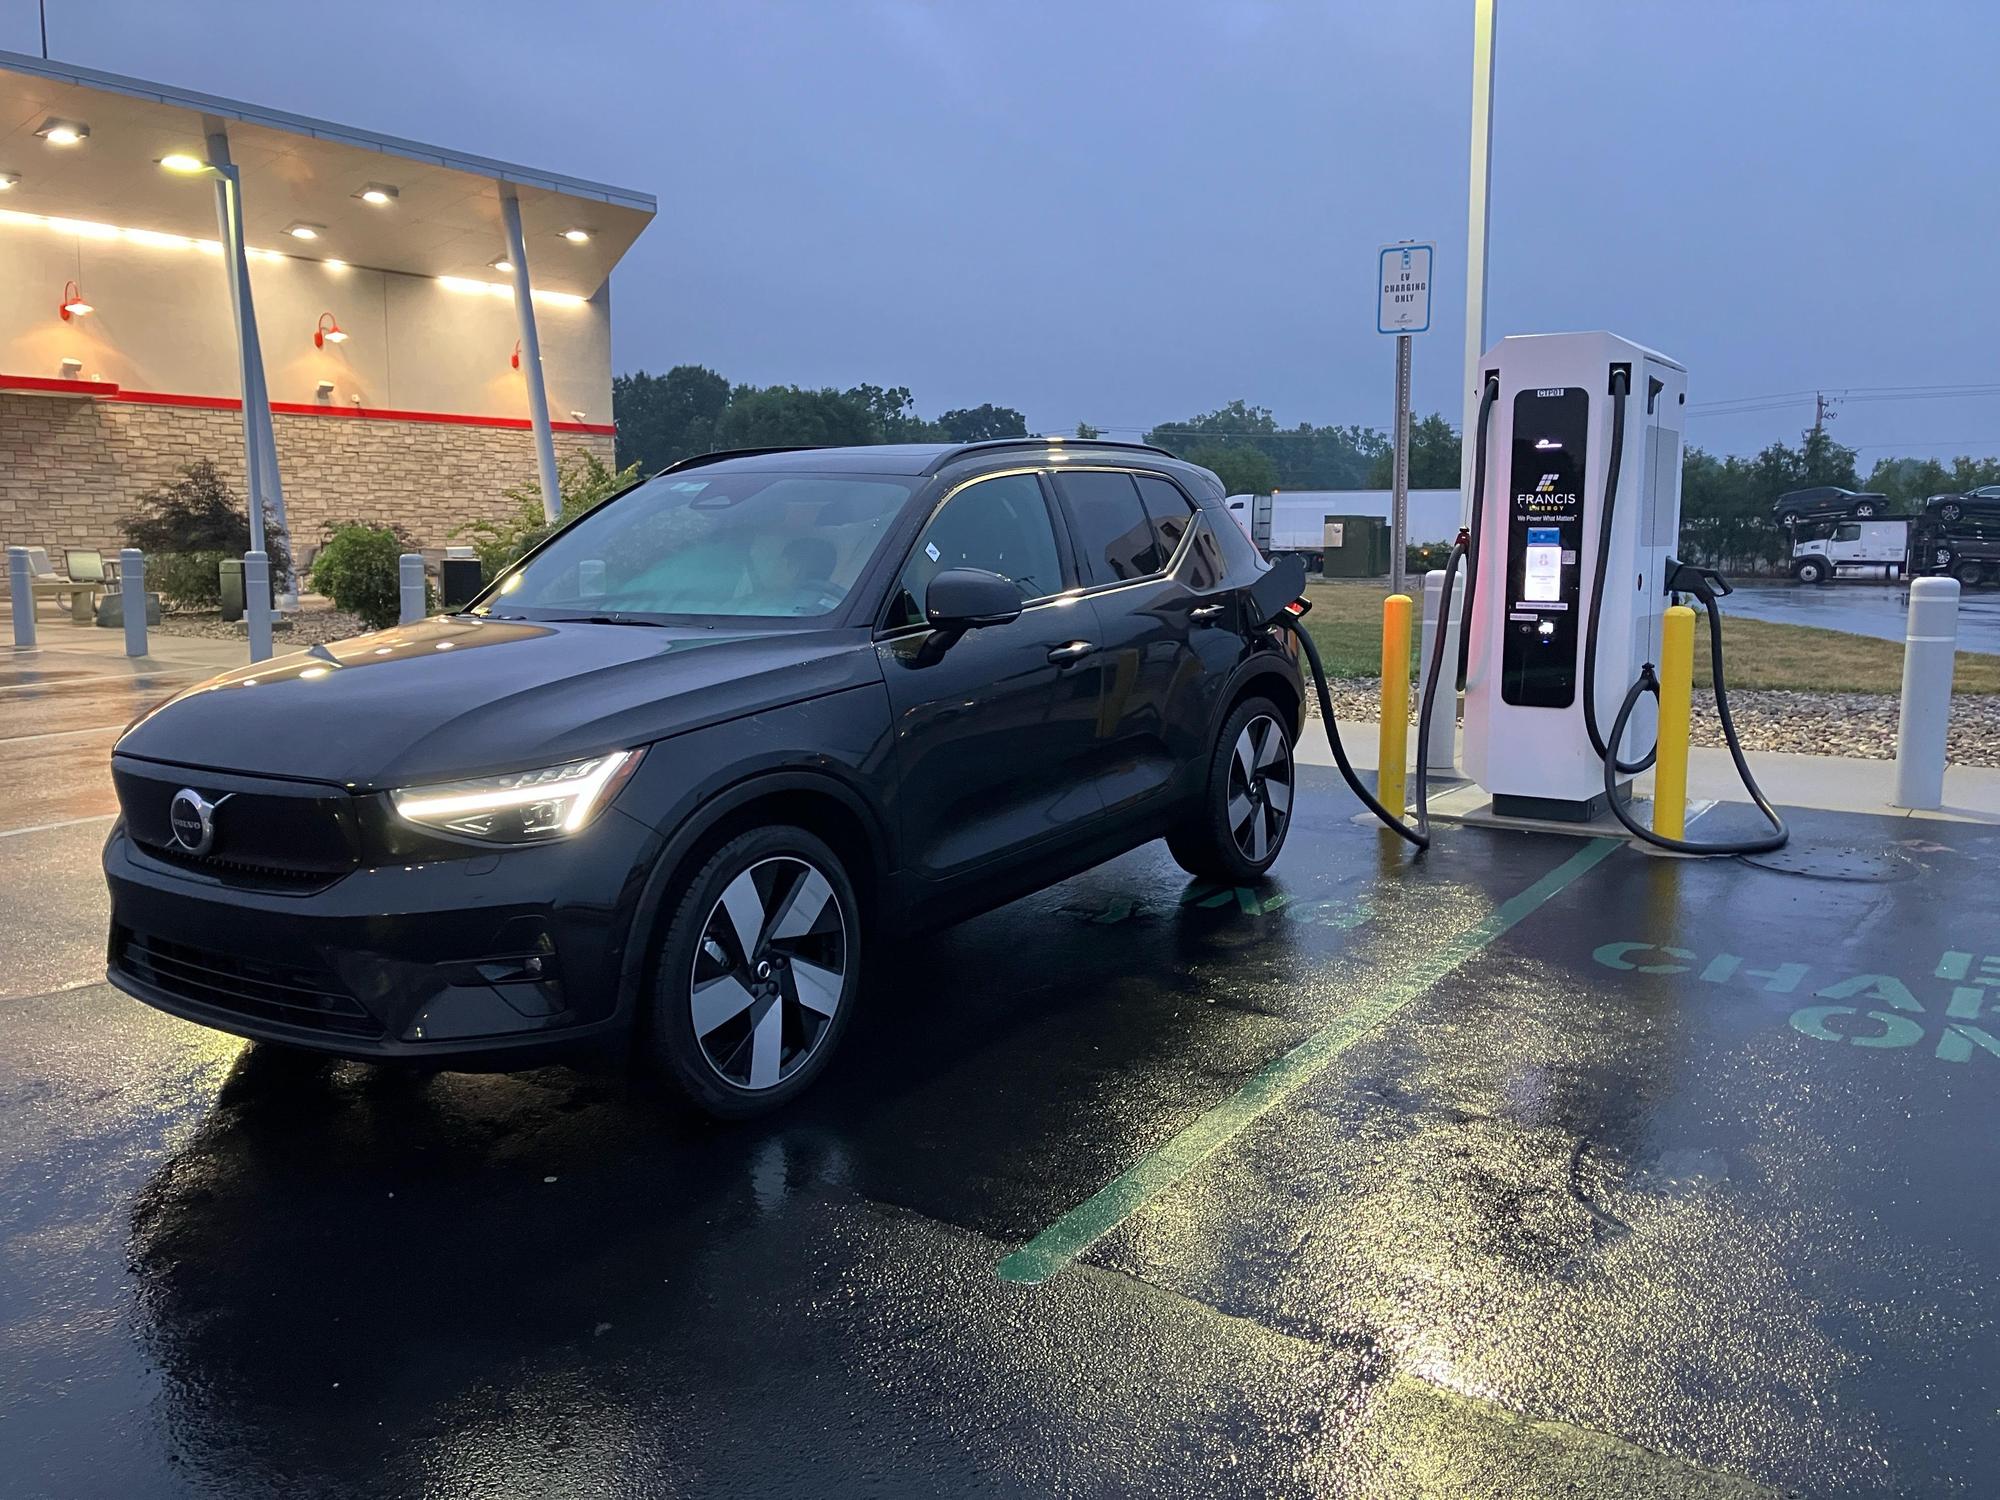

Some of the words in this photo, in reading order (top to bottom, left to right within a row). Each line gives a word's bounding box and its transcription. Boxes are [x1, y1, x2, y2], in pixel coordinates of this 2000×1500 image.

[1401, 273, 1410, 281] EV
[1385, 283, 1425, 293] CHARGING
[1395, 294, 1414, 303] ONLY
[1517, 494, 1576, 504] FRANCIS
[174, 818, 201, 830] VOLVO
